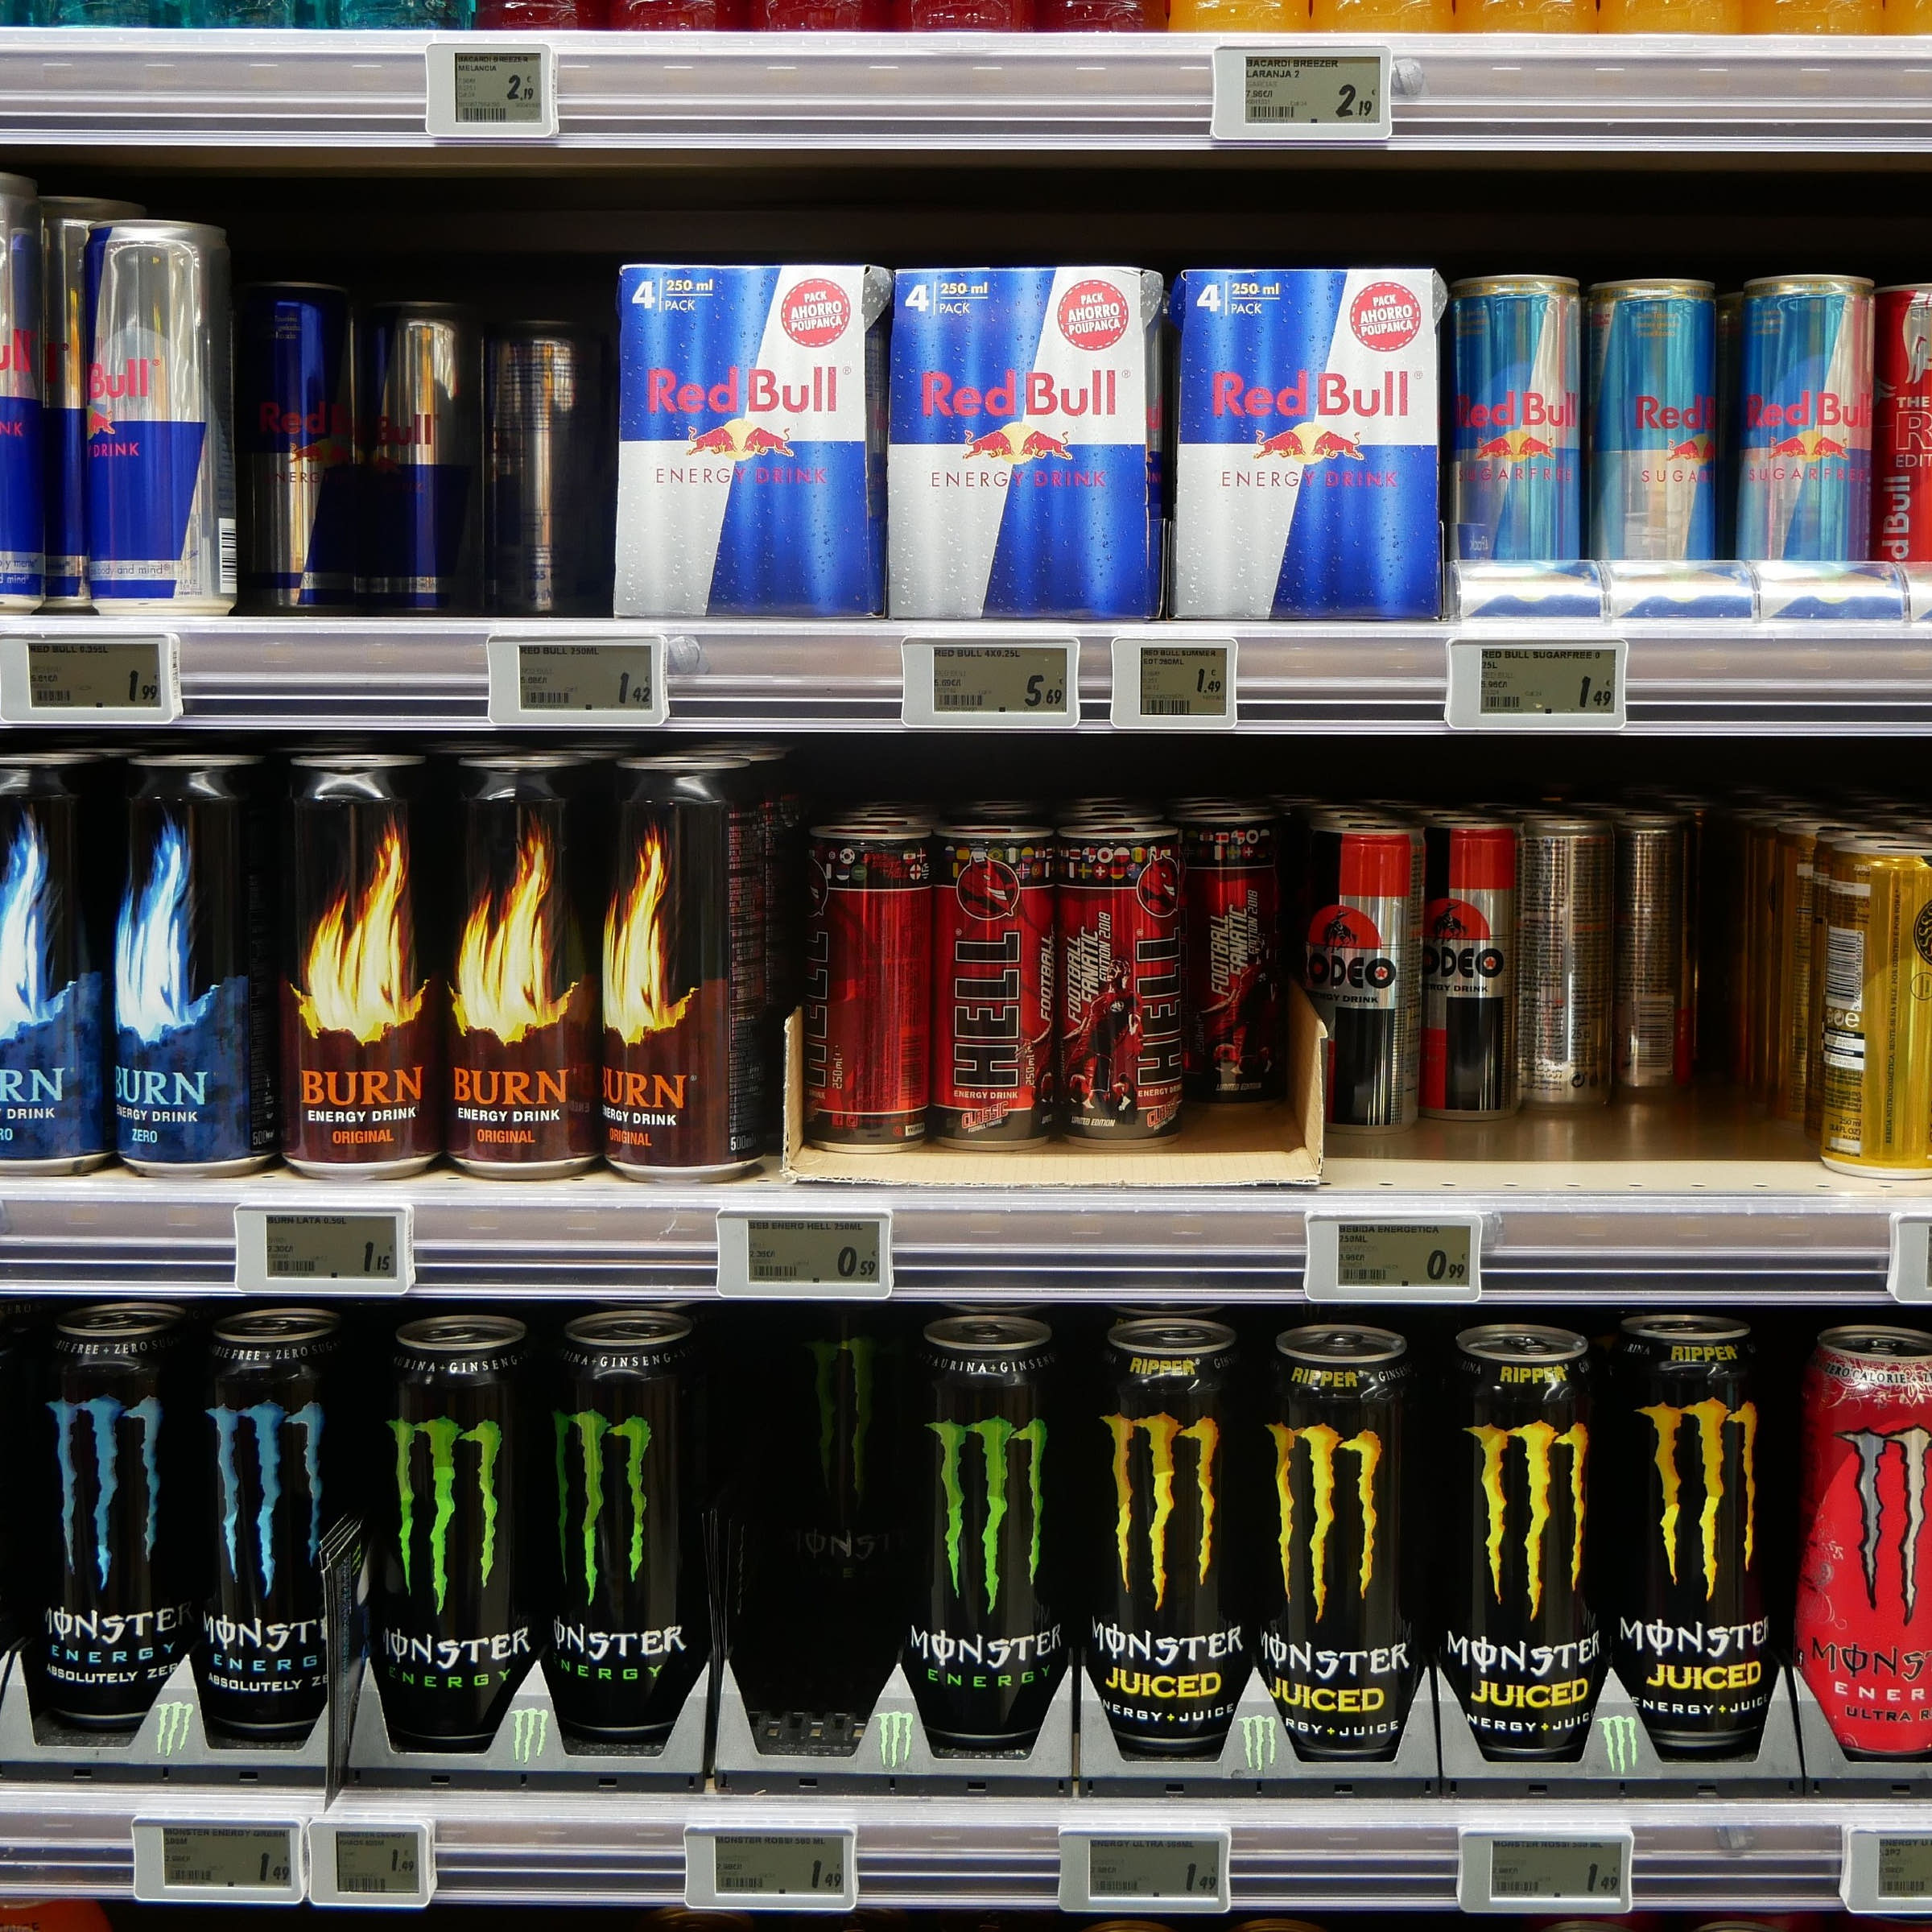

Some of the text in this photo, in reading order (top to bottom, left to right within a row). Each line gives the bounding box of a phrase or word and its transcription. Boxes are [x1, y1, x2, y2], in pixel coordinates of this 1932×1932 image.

[1246, 59, 1339, 68] BACARDI BREEZER
[1246, 69, 1300, 78] LARANJA 2
[667, 279, 713, 291] 250 ml
[940, 282, 988, 294] 250 ml
[1232, 283, 1279, 295] 250 ml
[632, 281, 655, 308] 4
[804, 291, 827, 302] PACK
[905, 284, 929, 312] 4
[1080, 292, 1104, 304] PACK
[1197, 284, 1221, 312] 4
[1373, 294, 1397, 307] PACK
[665, 300, 695, 311] PACK
[791, 300, 843, 320] AHORRO
[939, 303, 970, 315] PACK
[1067, 303, 1120, 322] AHORRO
[1231, 303, 1261, 314] PACK
[1360, 304, 1413, 324] AHORRO
[791, 316, 843, 332] POUPANÇA
[1068, 319, 1121, 336] POUPANÇA
[1360, 320, 1413, 336] POUPANÇA
[89, 358, 149, 398] Bull
[647, 365, 837, 413] Red Bull
[922, 369, 1117, 417] Red Bull
[1212, 370, 1408, 417] Red Bull
[1456, 391, 1579, 428] Red Bull
[1747, 390, 1871, 428] Red Bull
[1896, 396, 1930, 407] THE
[258, 402, 326, 435] Red
[1635, 394, 1700, 430] Red
[93, 444, 138, 457] DRINK
[656, 468, 828, 484] ENERGY DRINK
[931, 471, 1106, 487] ENERGY DRINK
[1222, 471, 1398, 487] ENERGY DRINK
[1459, 468, 1571, 481] SUGARFREE
[1748, 467, 1866, 481] SUGARFREE
[1883, 476, 1910, 534] Bull
[117, 564, 134, 575] and
[31, 645, 77, 653] RED BULL
[521, 647, 599, 655] RED BULL 250ML
[935, 649, 1020, 658] RED BULL 4X0.25L
[1481, 650, 1501, 658] RED
[1505, 650, 1529, 658] BULL
[1533, 650, 1592, 658] SUGARFREE
[1098, 911, 1112, 940] 2018
[1228, 904, 1247, 976] FANATIC
[1211, 914, 1230, 997] FOOTBALL
[1080, 926, 1099, 1003] FANATIC
[1067, 935, 1084, 1024] FOOTBALL
[1453, 985, 1488, 993] DRINK
[1137, 927, 1182, 1087] HELL
[1342, 995, 1378, 1004] DRINK
[954, 931, 1020, 1088] HELL
[301, 1067, 424, 1106] BURN
[454, 1067, 569, 1105] BURN
[1138, 1087, 1167, 1097] ENERGY
[954, 1090, 1018, 1100] ENERGY DRINK
[7, 1107, 56, 1120] DRINK
[152, 1110, 197, 1123] DRINK
[308, 1107, 416, 1123] ENERGY DRINK
[458, 1107, 560, 1123] ENERGY DRINK
[633, 1112, 676, 1125] DRINK
[961, 1100, 1010, 1128] CLASSIC
[131, 1129, 158, 1143] ZERO
[332, 1129, 394, 1145] ORIGINAL
[477, 1128, 535, 1143] ORIGINAL
[609, 1127, 652, 1146] ORIGINAL
[267, 1216, 294, 1224] BURN
[296, 1216, 321, 1224] LATA
[807, 1223, 831, 1231] HELL
[1339, 1225, 1439, 1233] BEBIDA ENERGETICA
[71, 1341, 148, 1355] FREE ZERO
[233, 1346, 308, 1360] FREE ZERO
[1670, 1345, 1737, 1362] RIPPER
[449, 1355, 518, 1373] GINSENG
[600, 1353, 671, 1368] GINSENG
[1129, 1356, 1195, 1376] RIPPER
[1290, 1367, 1357, 1388] RIPPER
[1500, 1365, 1567, 1384] RIPPER
[1825, 1363, 1906, 1384] ZERO CALORIE
[1092, 1616, 1243, 1666] MONSTER
[1620, 1615, 1769, 1657] MONSTER
[52, 1641, 175, 1663] ENERGY
[910, 1623, 1061, 1669] MONSTER
[1447, 1629, 1600, 1677] MONSTER
[47, 1663, 138, 1683] ABSOLUTELY
[389, 1666, 511, 1688] ENERGY
[927, 1665, 1051, 1687] ENERGY
[1646, 1661, 1761, 1690] JUICED
[208, 1672, 303, 1692] ABSOLUTELY
[1105, 1666, 1221, 1699] JUICED
[1270, 1678, 1385, 1713] JUICED
[1471, 1678, 1588, 1708] JUICED
[1179, 1703, 1234, 1722] JUICE
[1845, 1706, 1913, 1723] ULTRA
[1340, 1719, 1398, 1736] JUICE
[164, 1829, 209, 1837] MONSTER
[1091, 1840, 1164, 1848] ENERGY ULTRA
